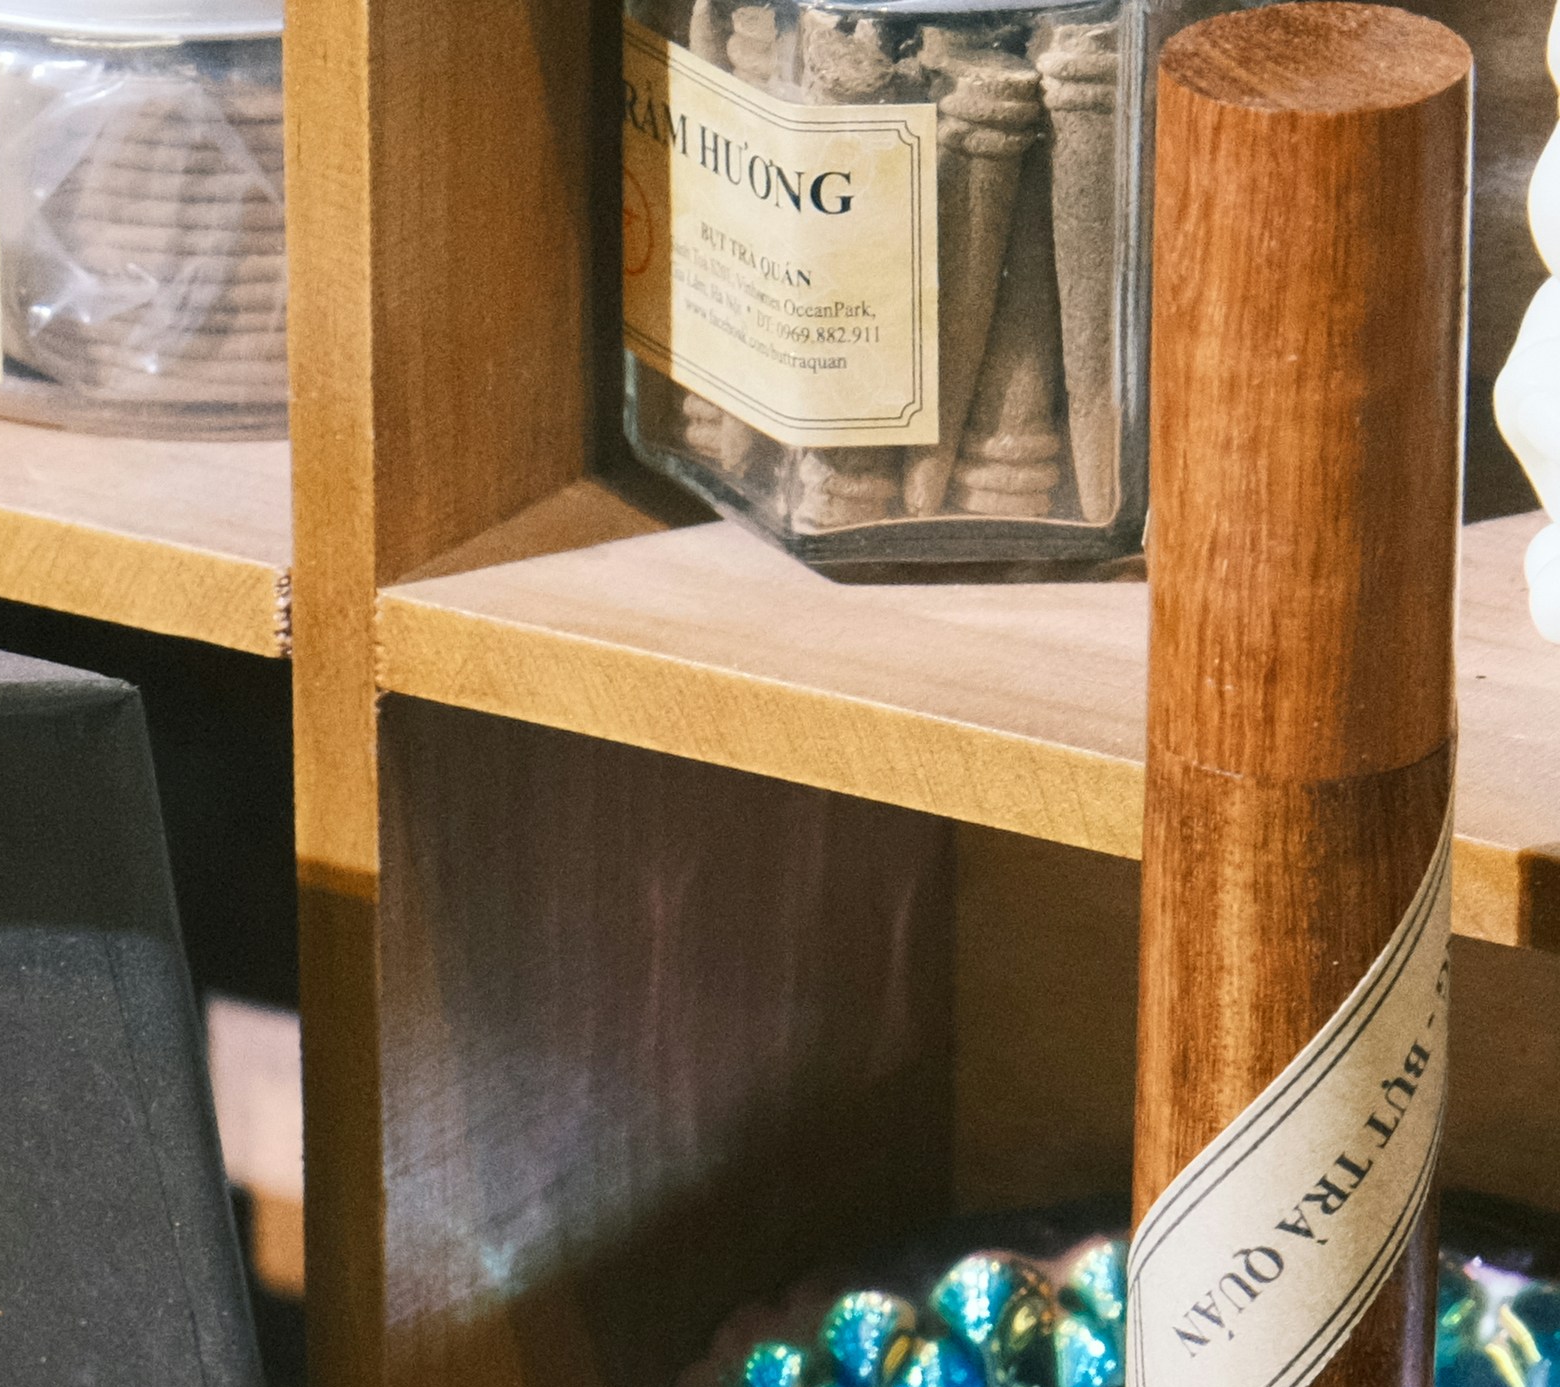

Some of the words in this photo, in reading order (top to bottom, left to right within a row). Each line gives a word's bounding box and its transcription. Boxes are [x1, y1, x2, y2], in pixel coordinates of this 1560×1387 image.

[700, 123, 855, 215] HƯƠNG
[760, 256, 813, 288] QUÁN
[783, 298, 877, 320] OceanPark,
[776, 321, 880, 344] 0969.882.911
[1364, 1038, 1431, 1151] BỤT
[1275, 1150, 1373, 1245] TRÀ
[1170, 1243, 1287, 1360] QUÁN
